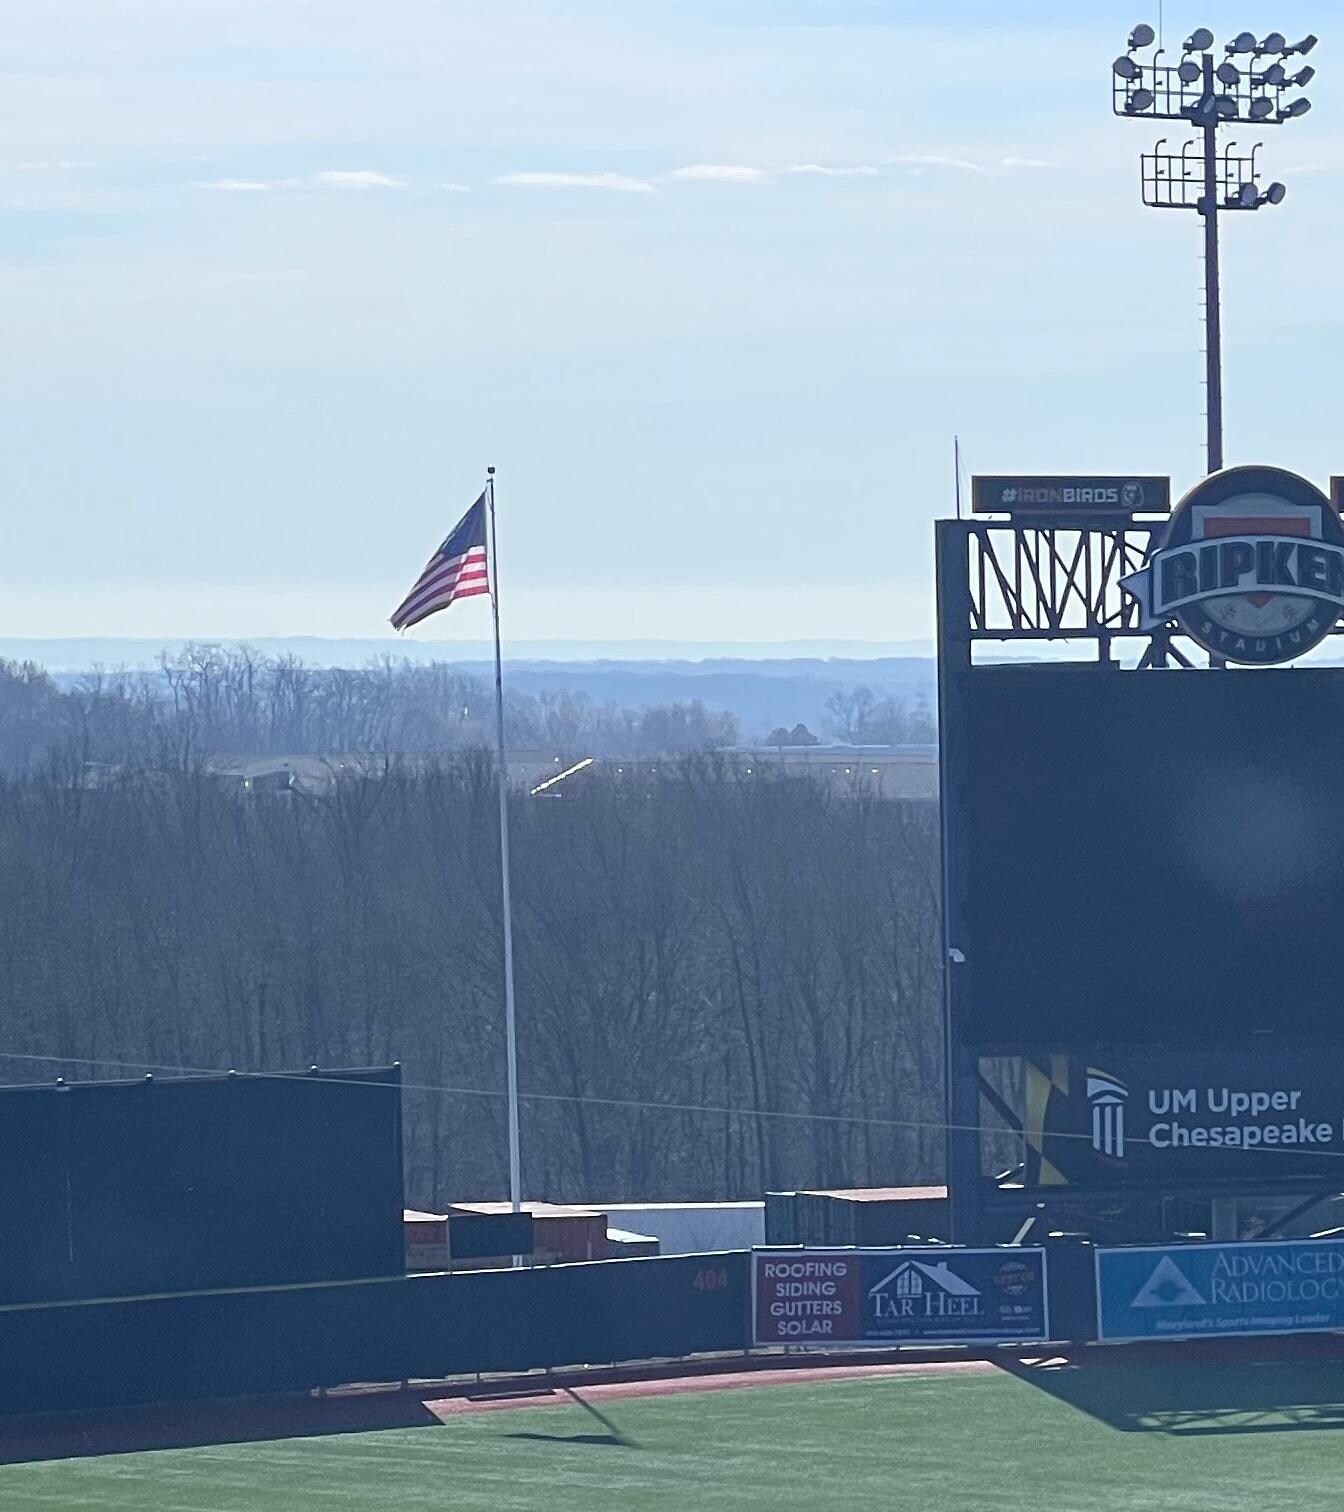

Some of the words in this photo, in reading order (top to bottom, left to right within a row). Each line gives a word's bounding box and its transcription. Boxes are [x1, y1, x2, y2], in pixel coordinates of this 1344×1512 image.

[1201, 618, 1320, 651] STADIUM
[1149, 1089, 1197, 1114] UM
[1207, 1088, 1301, 1116] Upper
[1149, 1118, 1333, 1149] Chesapeake
[765, 1262, 847, 1278] ROOFING
[1211, 1251, 1344, 1277] ADVANCED
[776, 1281, 836, 1296] SIDING
[770, 1300, 842, 1316] GUTTERS
[869, 1292, 914, 1317] TAR
[924, 1291, 985, 1316] HEEL
[778, 1320, 833, 1335] SOLAR
